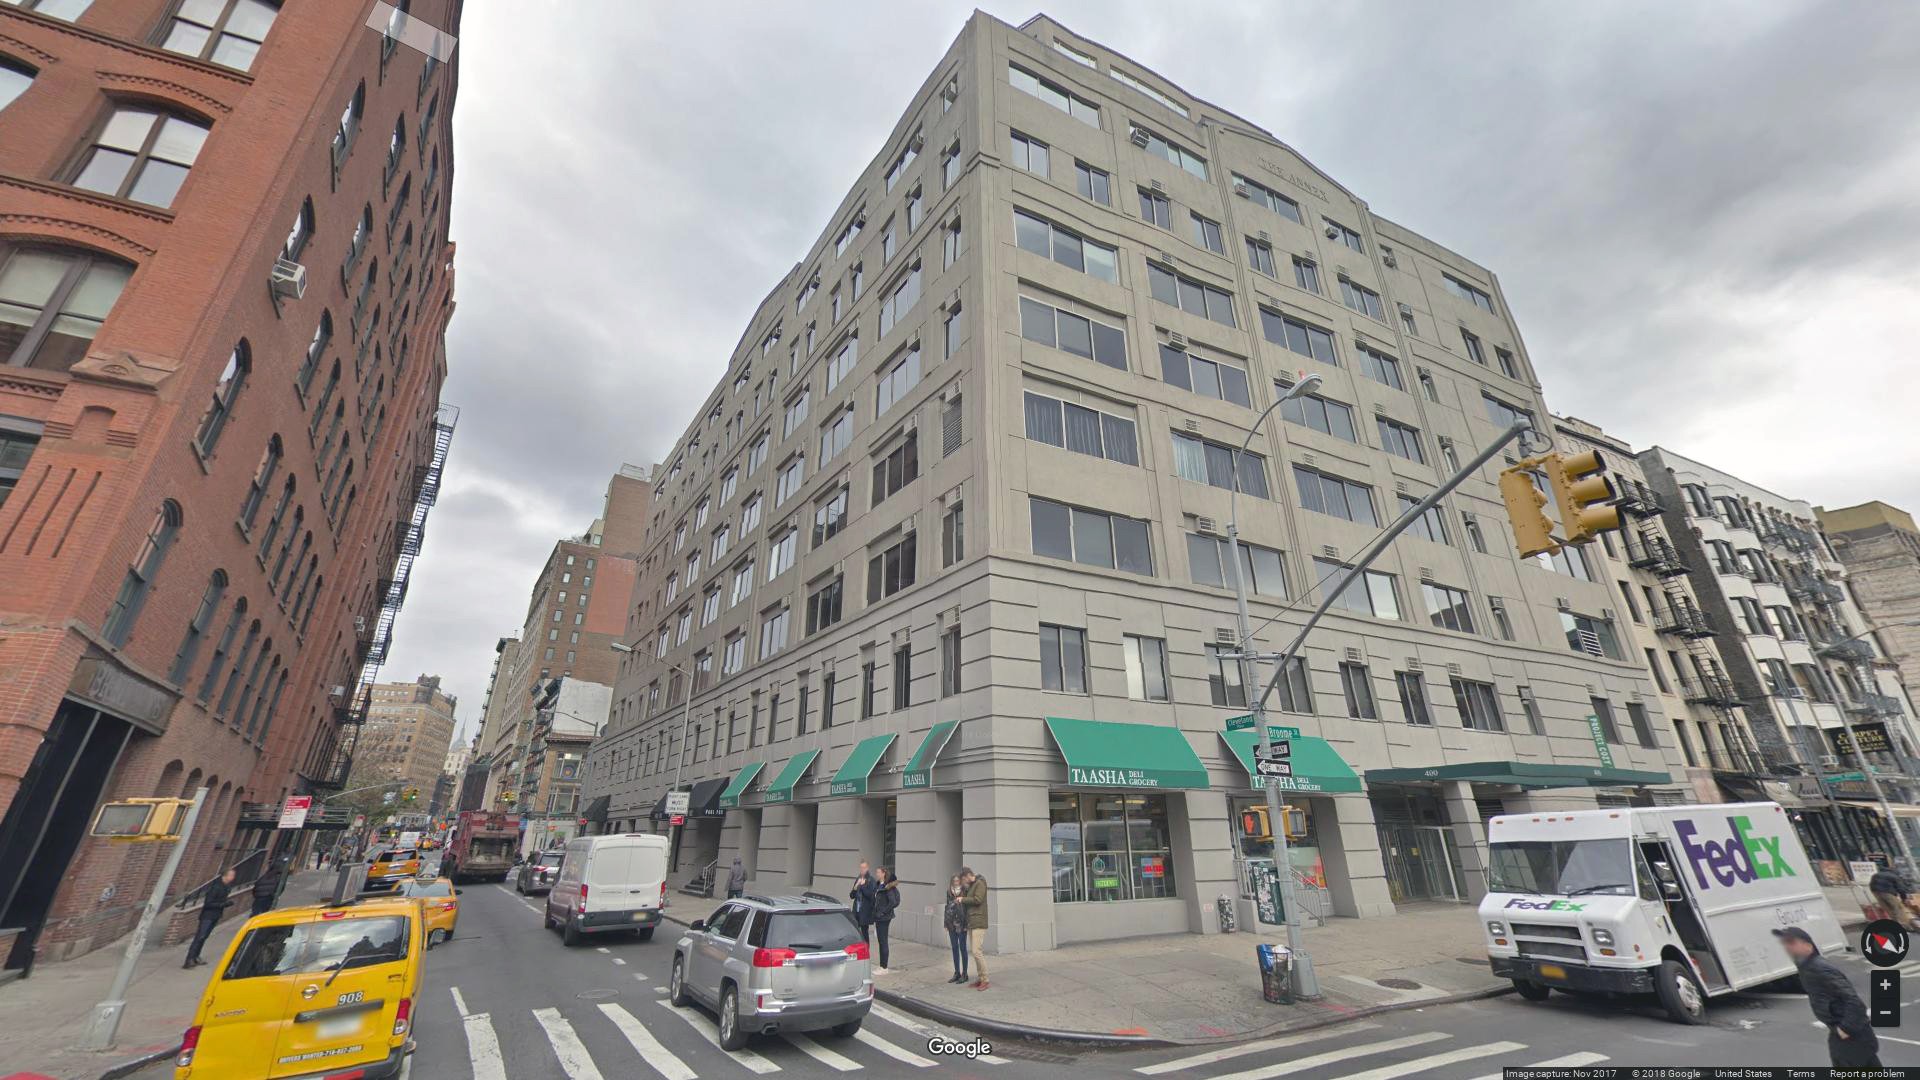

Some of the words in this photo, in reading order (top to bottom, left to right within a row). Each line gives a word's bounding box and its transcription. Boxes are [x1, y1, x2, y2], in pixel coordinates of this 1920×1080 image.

[1227, 715, 1254, 727] Cleveland
[1268, 727, 1293, 738] Broome
[1272, 744, 1286, 754] WAY
[1261, 763, 1271, 771] ONE
[1275, 764, 1288, 772] WAY
[904, 774, 926, 786] TAASHA
[1071, 768, 1127, 785] TAASHA
[1128, 770, 1144, 778] DELI
[1128, 778, 1158, 787] GROCERY
[1673, 816, 1796, 890] FedEx
[1504, 898, 1587, 912] FedEx
[338, 991, 364, 1006] 908
